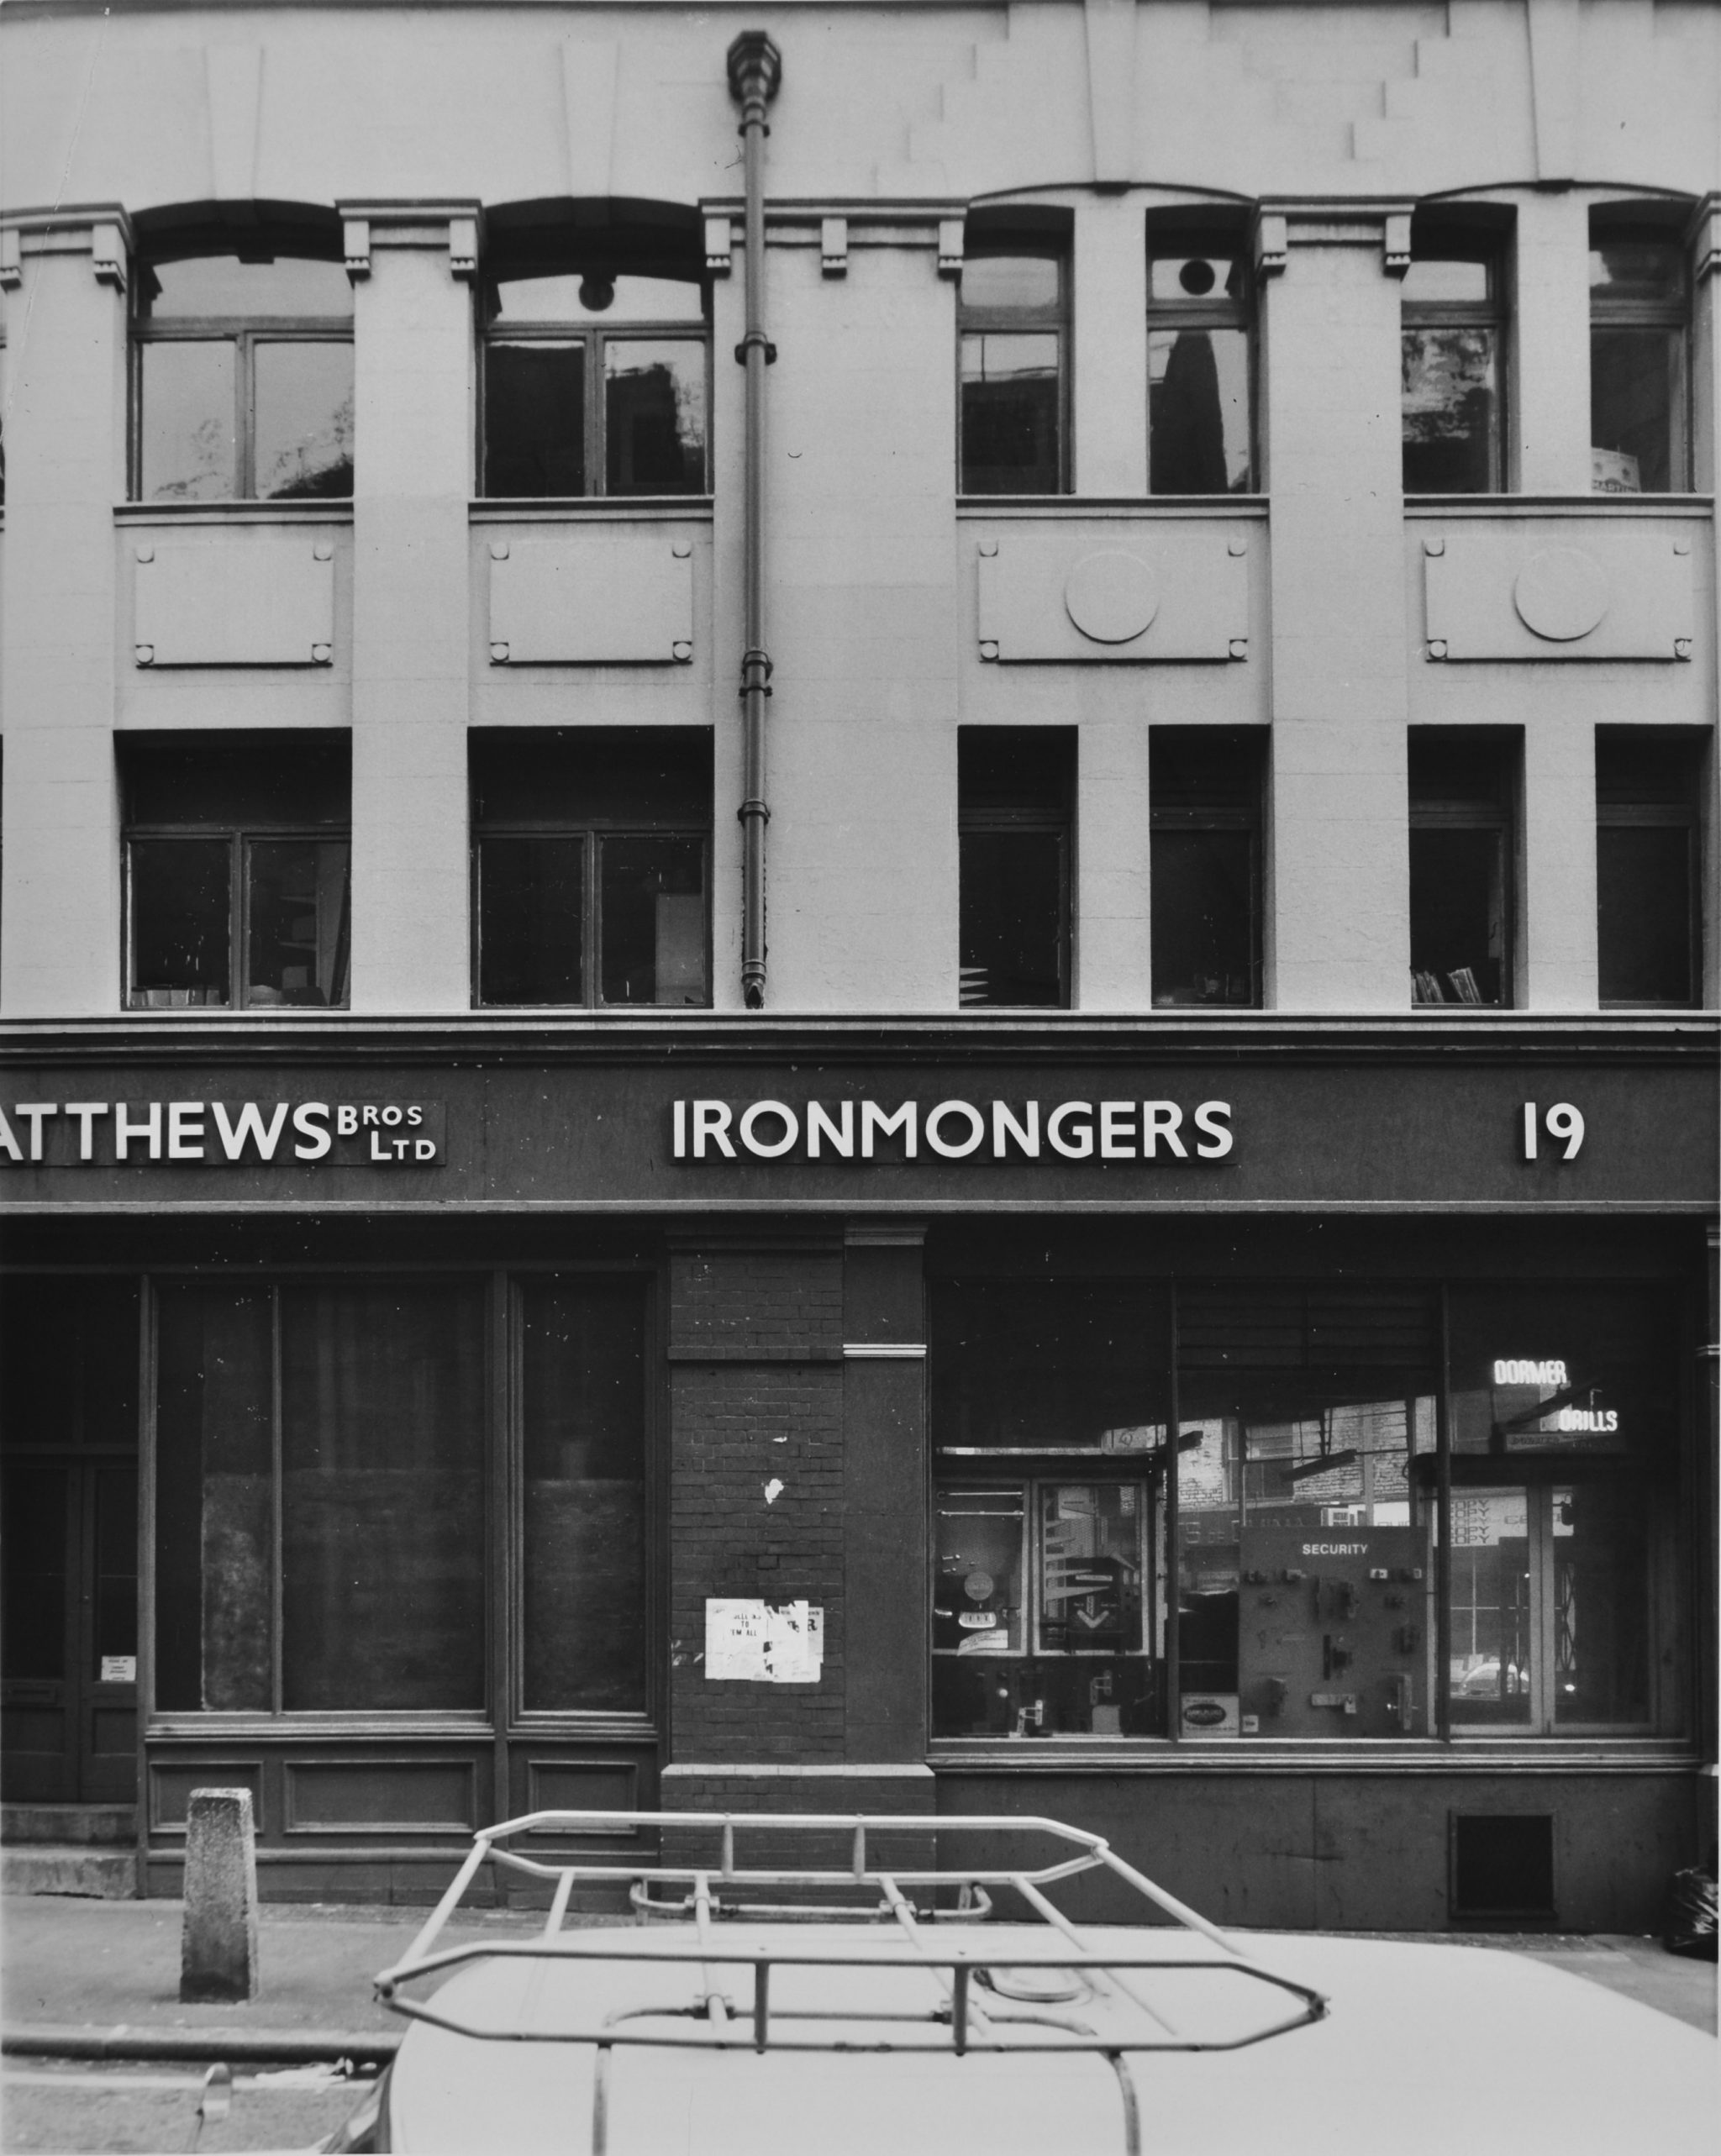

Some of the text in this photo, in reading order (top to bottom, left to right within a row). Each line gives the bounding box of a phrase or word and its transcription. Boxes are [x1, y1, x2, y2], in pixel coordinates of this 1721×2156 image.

[338, 1105, 423, 1135] BROS
[673, 1100, 1234, 1159] IRONMONGERS
[1524, 1102, 1585, 1160] 19
[371, 1131, 436, 1160] LTD
[1493, 1359, 1566, 1385] DORMER
[1558, 1408, 1618, 1432] DRILLS
[1303, 1543, 1368, 1555] SECURITY
